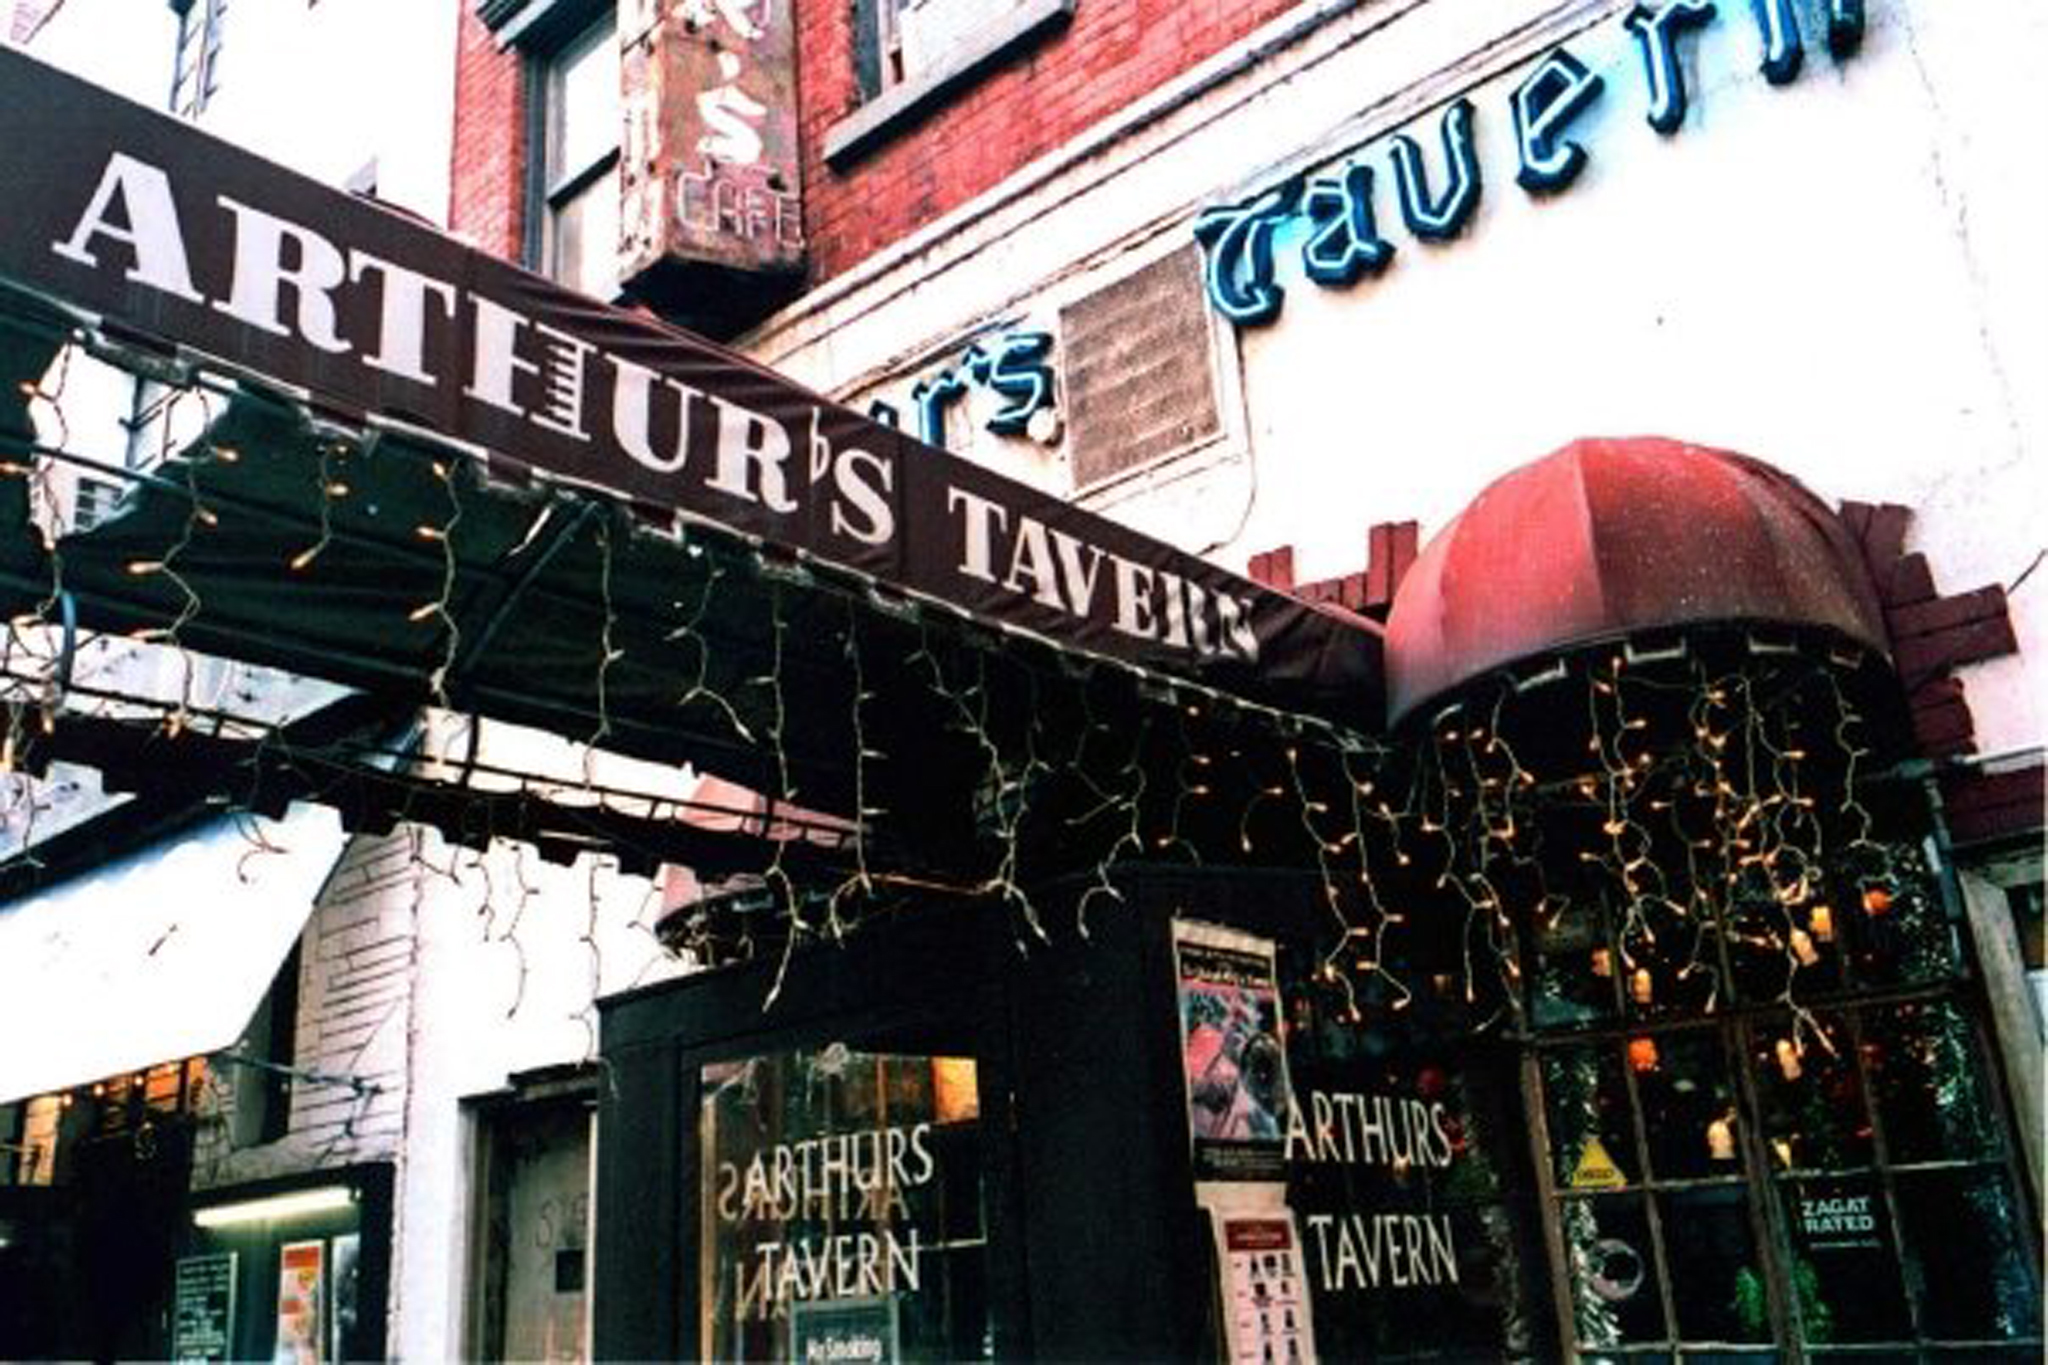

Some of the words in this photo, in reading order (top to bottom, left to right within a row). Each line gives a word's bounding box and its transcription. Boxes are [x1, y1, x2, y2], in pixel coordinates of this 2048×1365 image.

[948, 486, 1259, 663] TAVERN
[743, 1123, 934, 1206] ARTHURS
[1284, 1090, 1453, 1168] ARTHURS
[1800, 1195, 1870, 1217] ZAGAT
[1804, 1215, 1875, 1235] RATED
[756, 1228, 921, 1301] TAVERN
[1307, 1214, 1460, 1292] TAVERN
